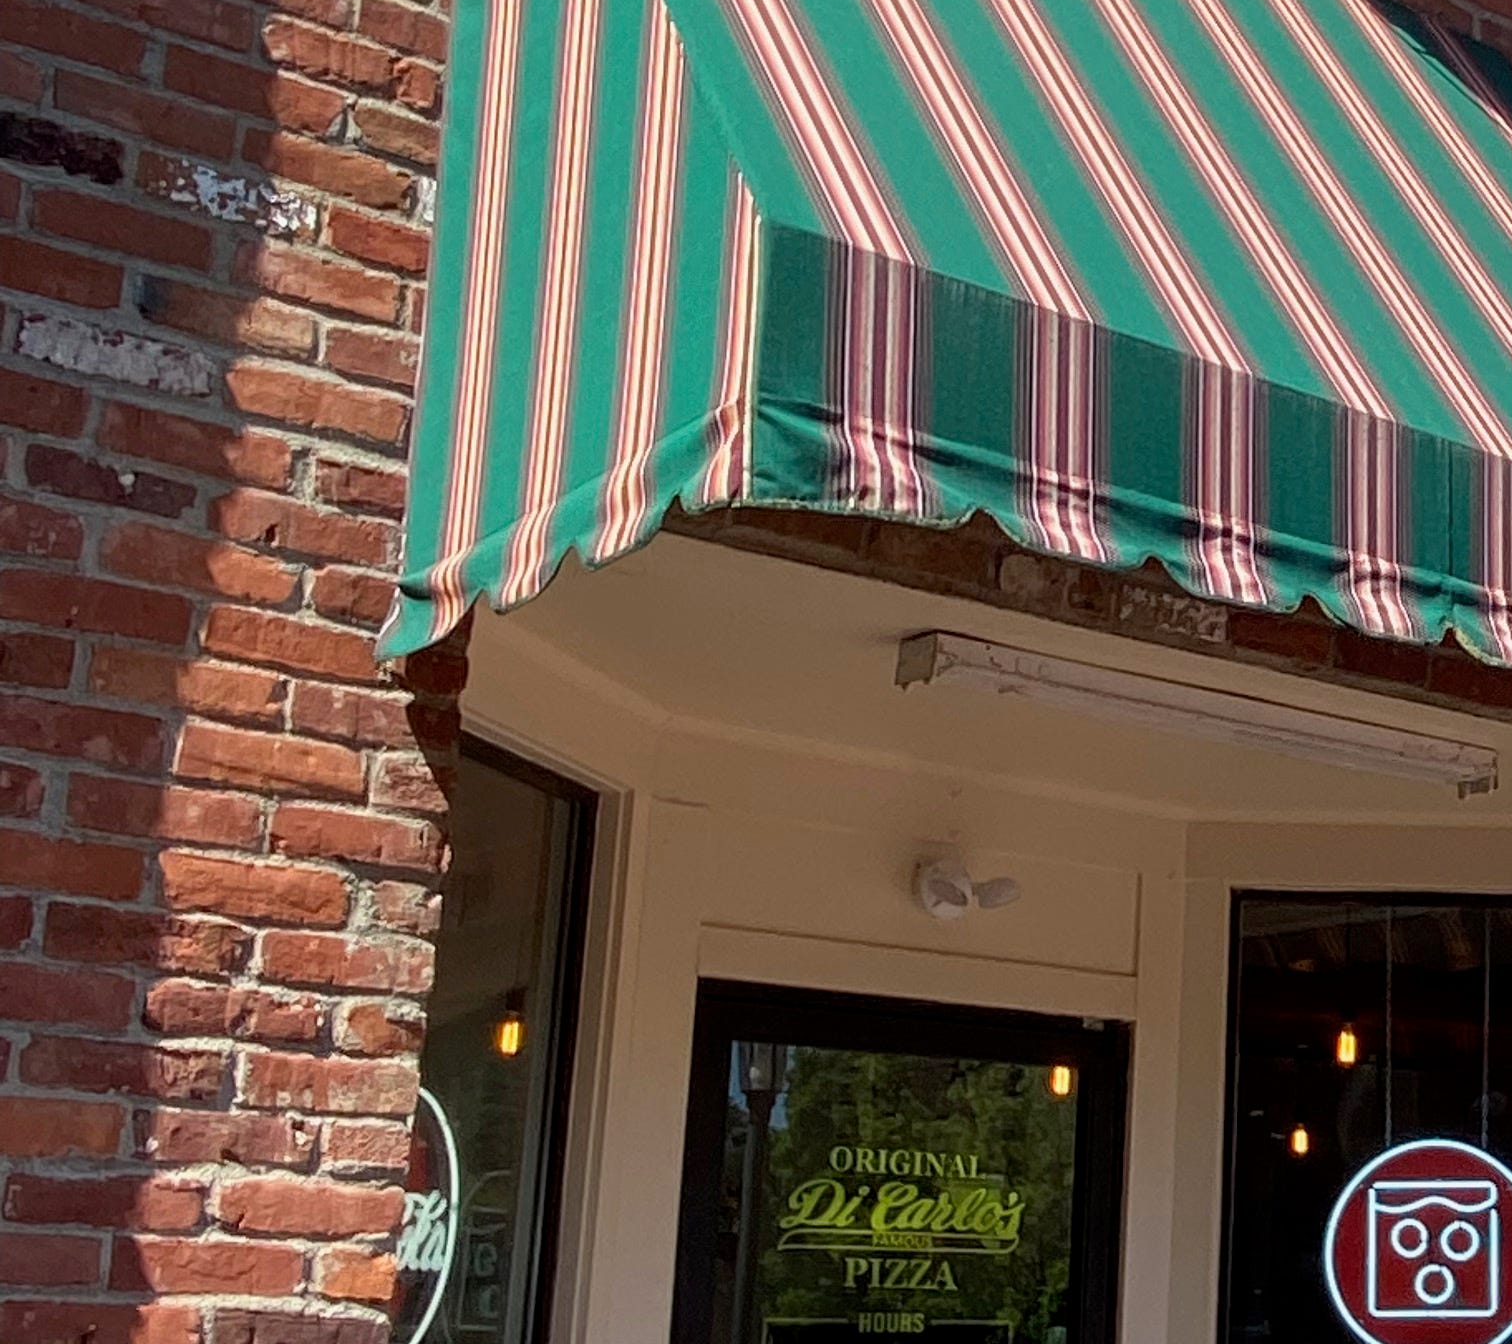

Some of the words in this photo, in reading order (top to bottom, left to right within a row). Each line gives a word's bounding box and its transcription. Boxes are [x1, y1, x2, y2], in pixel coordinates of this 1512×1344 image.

[829, 1145, 987, 1180] ORIGINAL
[779, 1178, 871, 1230] Di
[870, 1180, 1027, 1241] Carlo's
[843, 1257, 959, 1291] PIZZA
[858, 1312, 926, 1334] HOURS
